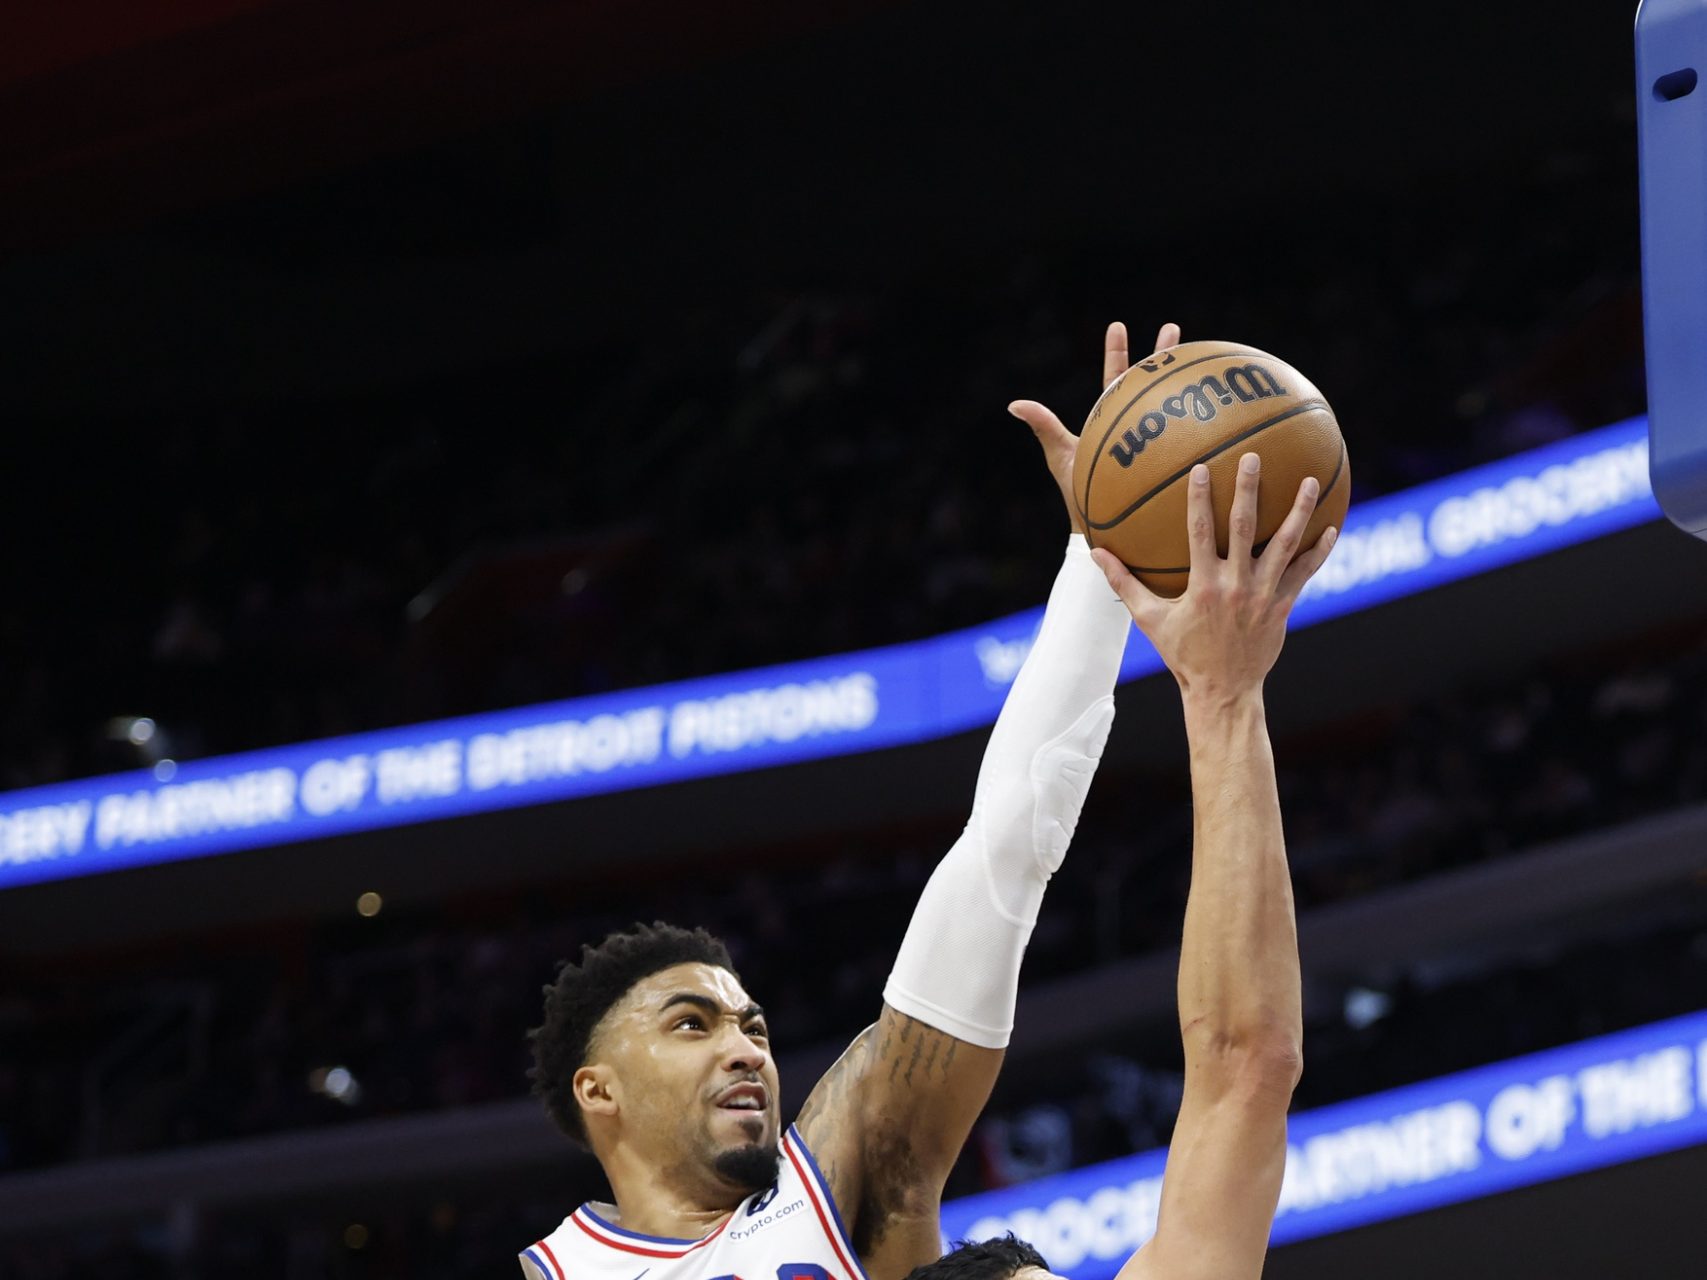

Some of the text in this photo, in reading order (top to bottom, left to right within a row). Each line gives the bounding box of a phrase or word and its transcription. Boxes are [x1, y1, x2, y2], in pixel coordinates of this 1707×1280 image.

[1109, 362, 1288, 469] Wilson
[95, 767, 298, 851] PARTNER
[300, 753, 373, 817] OF
[375, 738, 464, 807] THE
[466, 705, 665, 792] DETROIT
[668, 672, 879, 759] PISTONS
[1486, 1073, 1577, 1160] OF
[1577, 1045, 1697, 1140] THE
[729, 1199, 804, 1241] crypto.com
